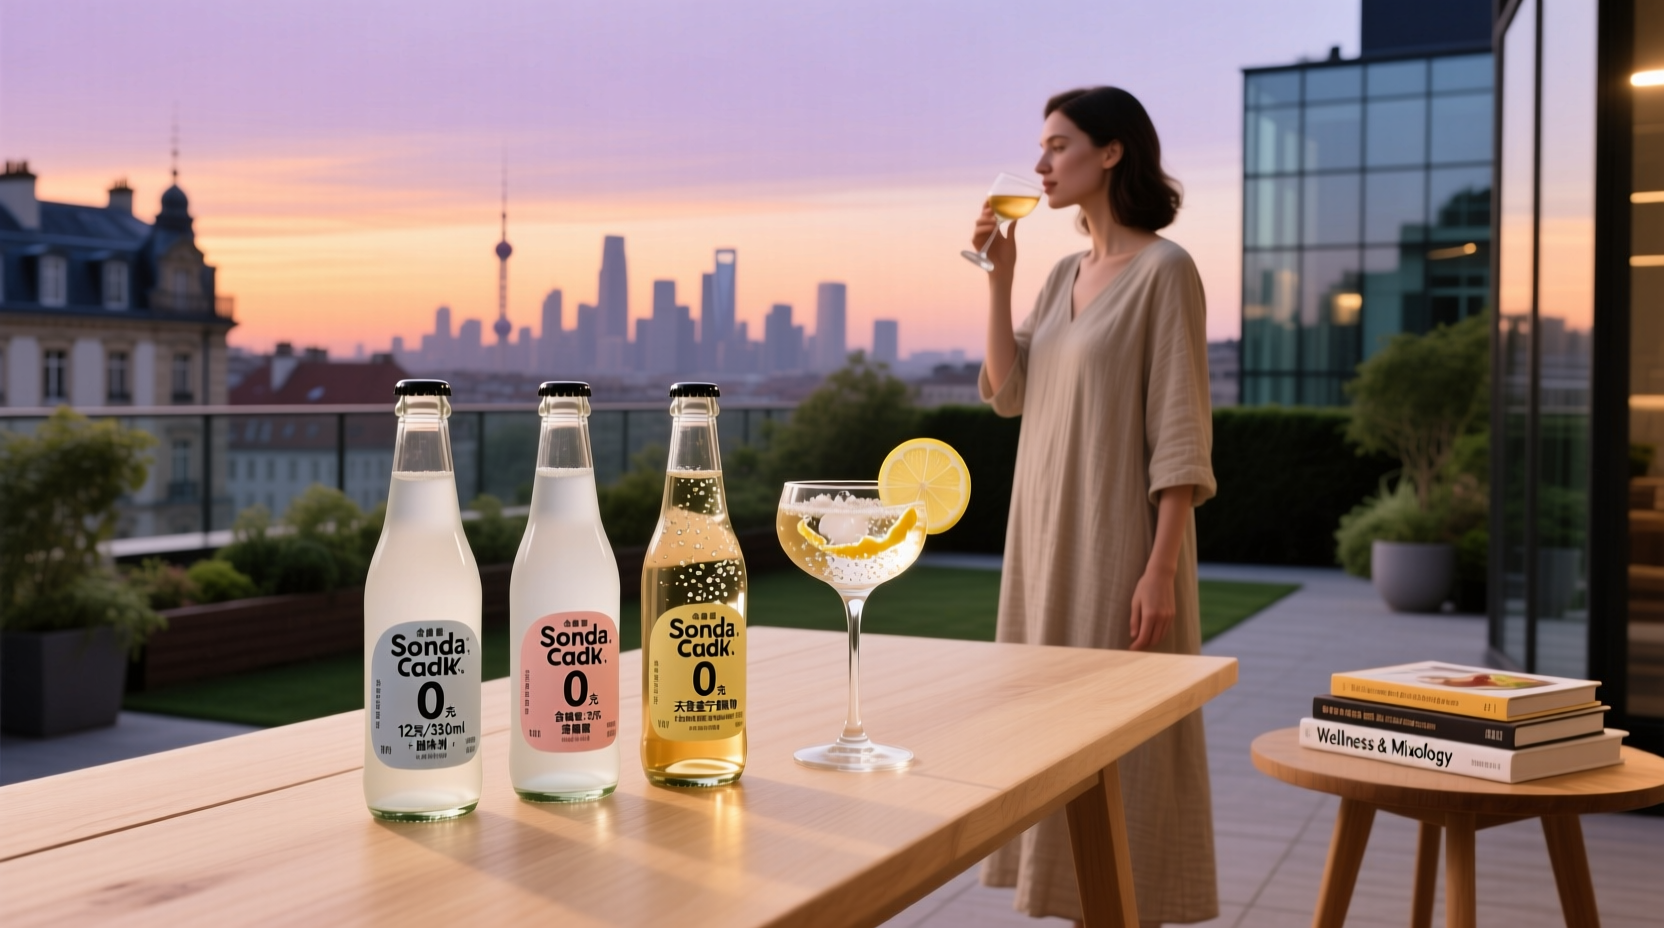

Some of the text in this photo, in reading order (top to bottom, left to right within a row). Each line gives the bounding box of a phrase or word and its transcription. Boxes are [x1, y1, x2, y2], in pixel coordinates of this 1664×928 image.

[1317, 726, 1374, 751] Wellness
[1377, 737, 1387, 754] &
[1392, 738, 1453, 768] Mixology
